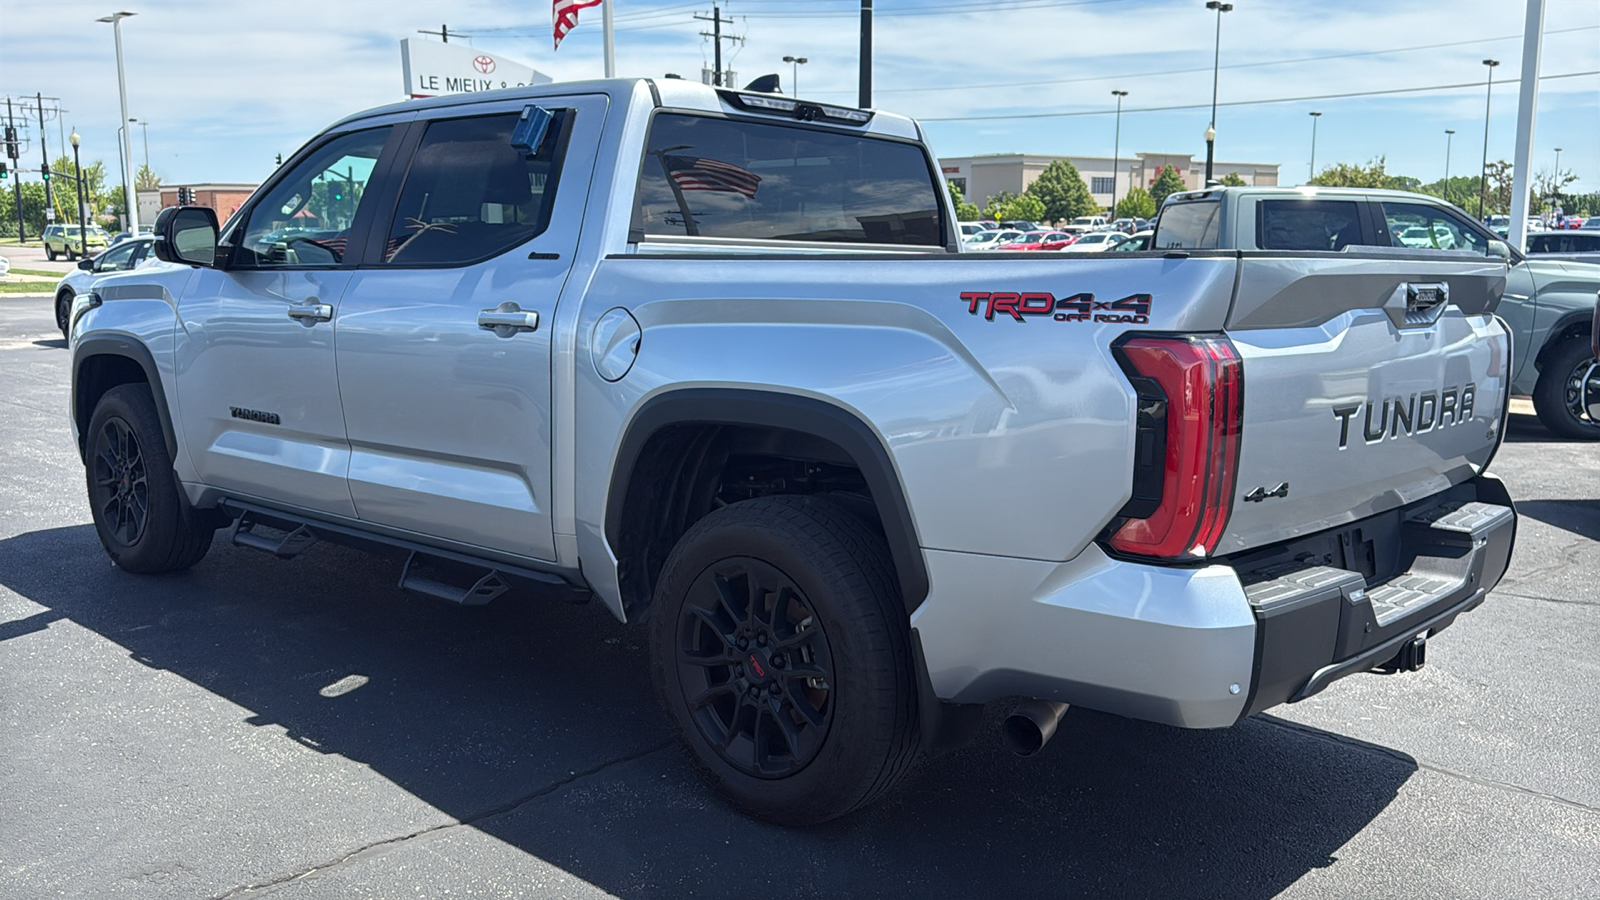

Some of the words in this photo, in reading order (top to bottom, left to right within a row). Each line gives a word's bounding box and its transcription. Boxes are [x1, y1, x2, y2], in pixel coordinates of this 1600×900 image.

[420, 75, 439, 91] LE
[446, 77, 492, 93] MIEUX
[960, 292, 1056, 323] TRD
[1053, 313, 1092, 323] OFF
[1093, 314, 1150, 325] ROAD
[229, 406, 281, 425] TUNDRA
[1332, 383, 1477, 450] TUNDRA
[750, 654, 765, 677] TRD
